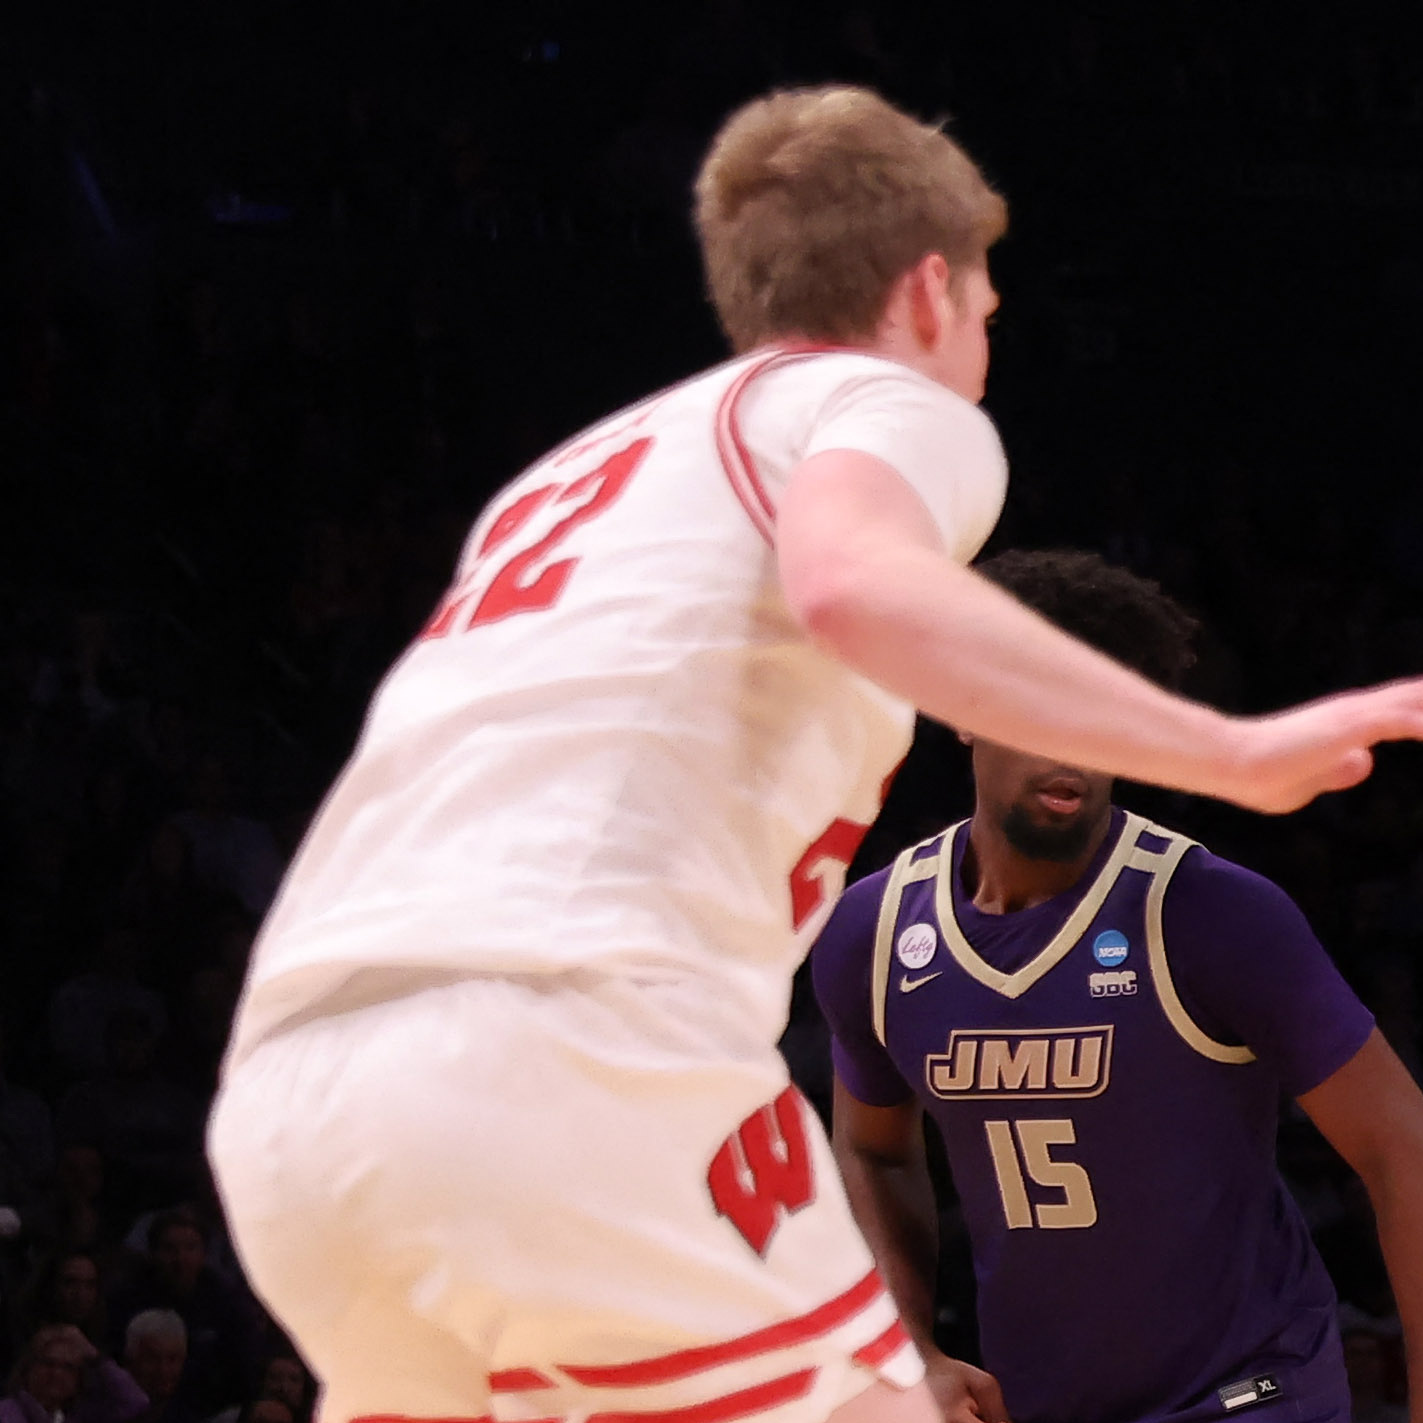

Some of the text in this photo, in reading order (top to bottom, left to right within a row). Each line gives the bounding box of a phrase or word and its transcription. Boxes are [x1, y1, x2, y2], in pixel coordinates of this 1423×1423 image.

[932, 1035, 1104, 1092] JMU
[983, 1118, 1098, 1231] 15
[1257, 1379, 1277, 1393] XL
